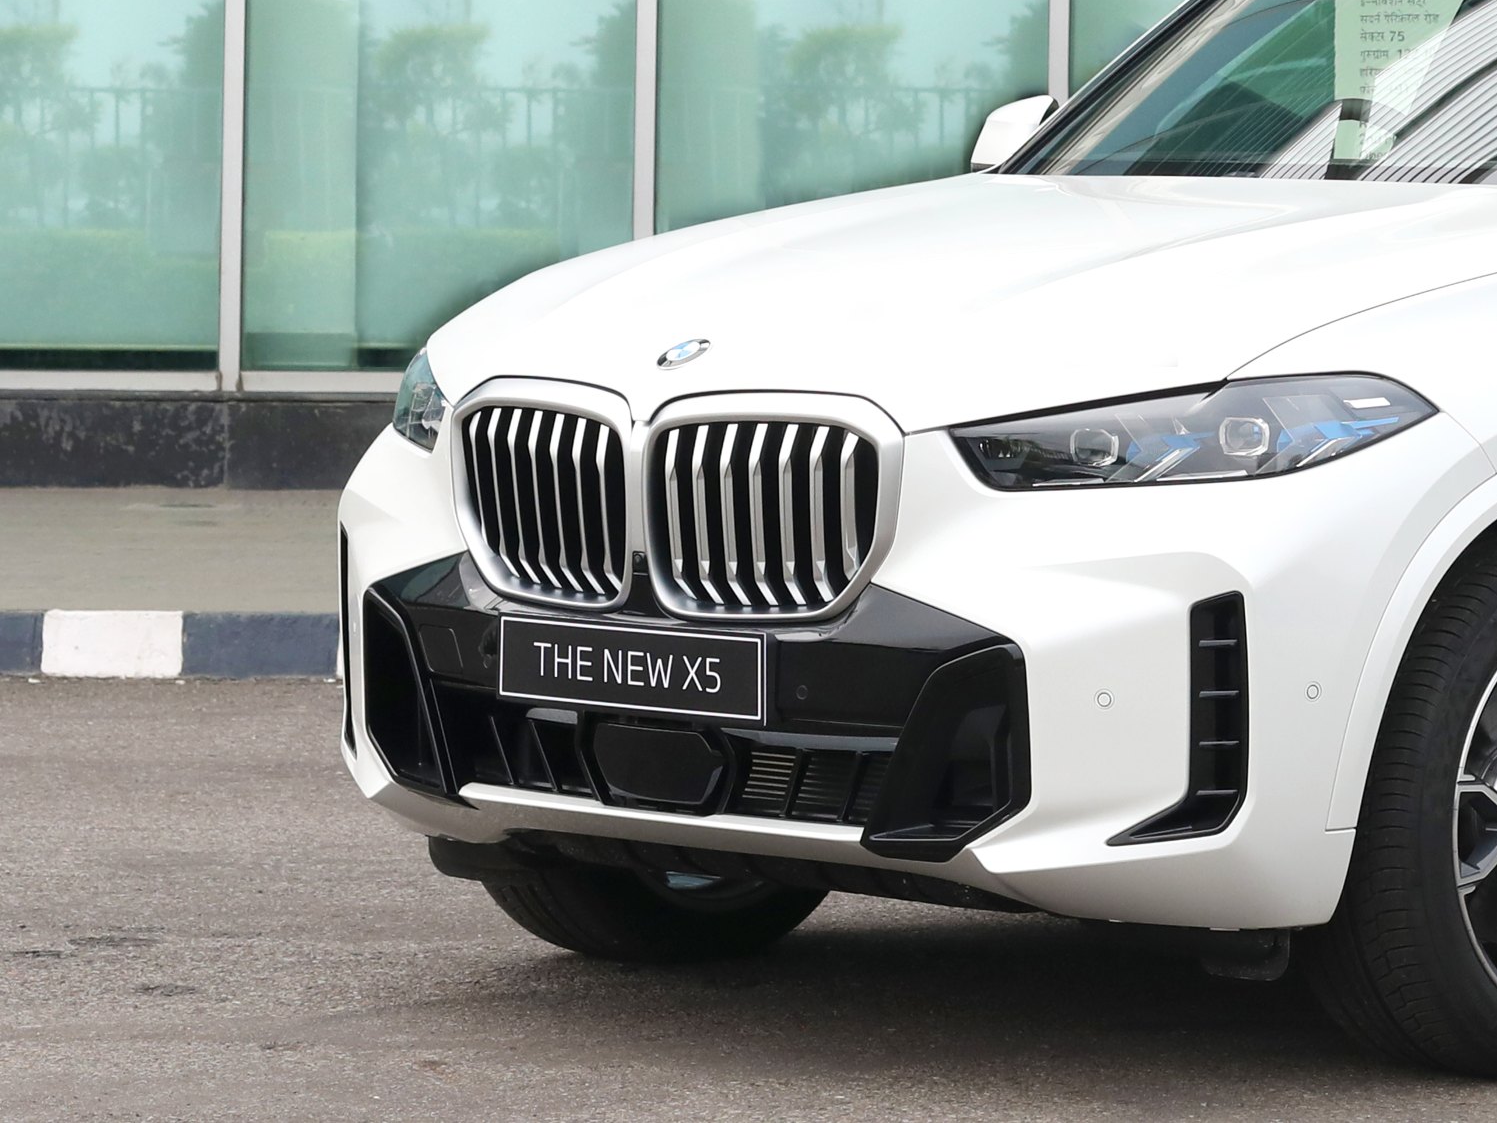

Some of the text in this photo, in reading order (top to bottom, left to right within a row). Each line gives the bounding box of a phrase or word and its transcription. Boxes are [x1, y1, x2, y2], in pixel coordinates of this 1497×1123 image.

[1389, 30, 1405, 42] 75
[533, 641, 722, 694] THE NEW X5
